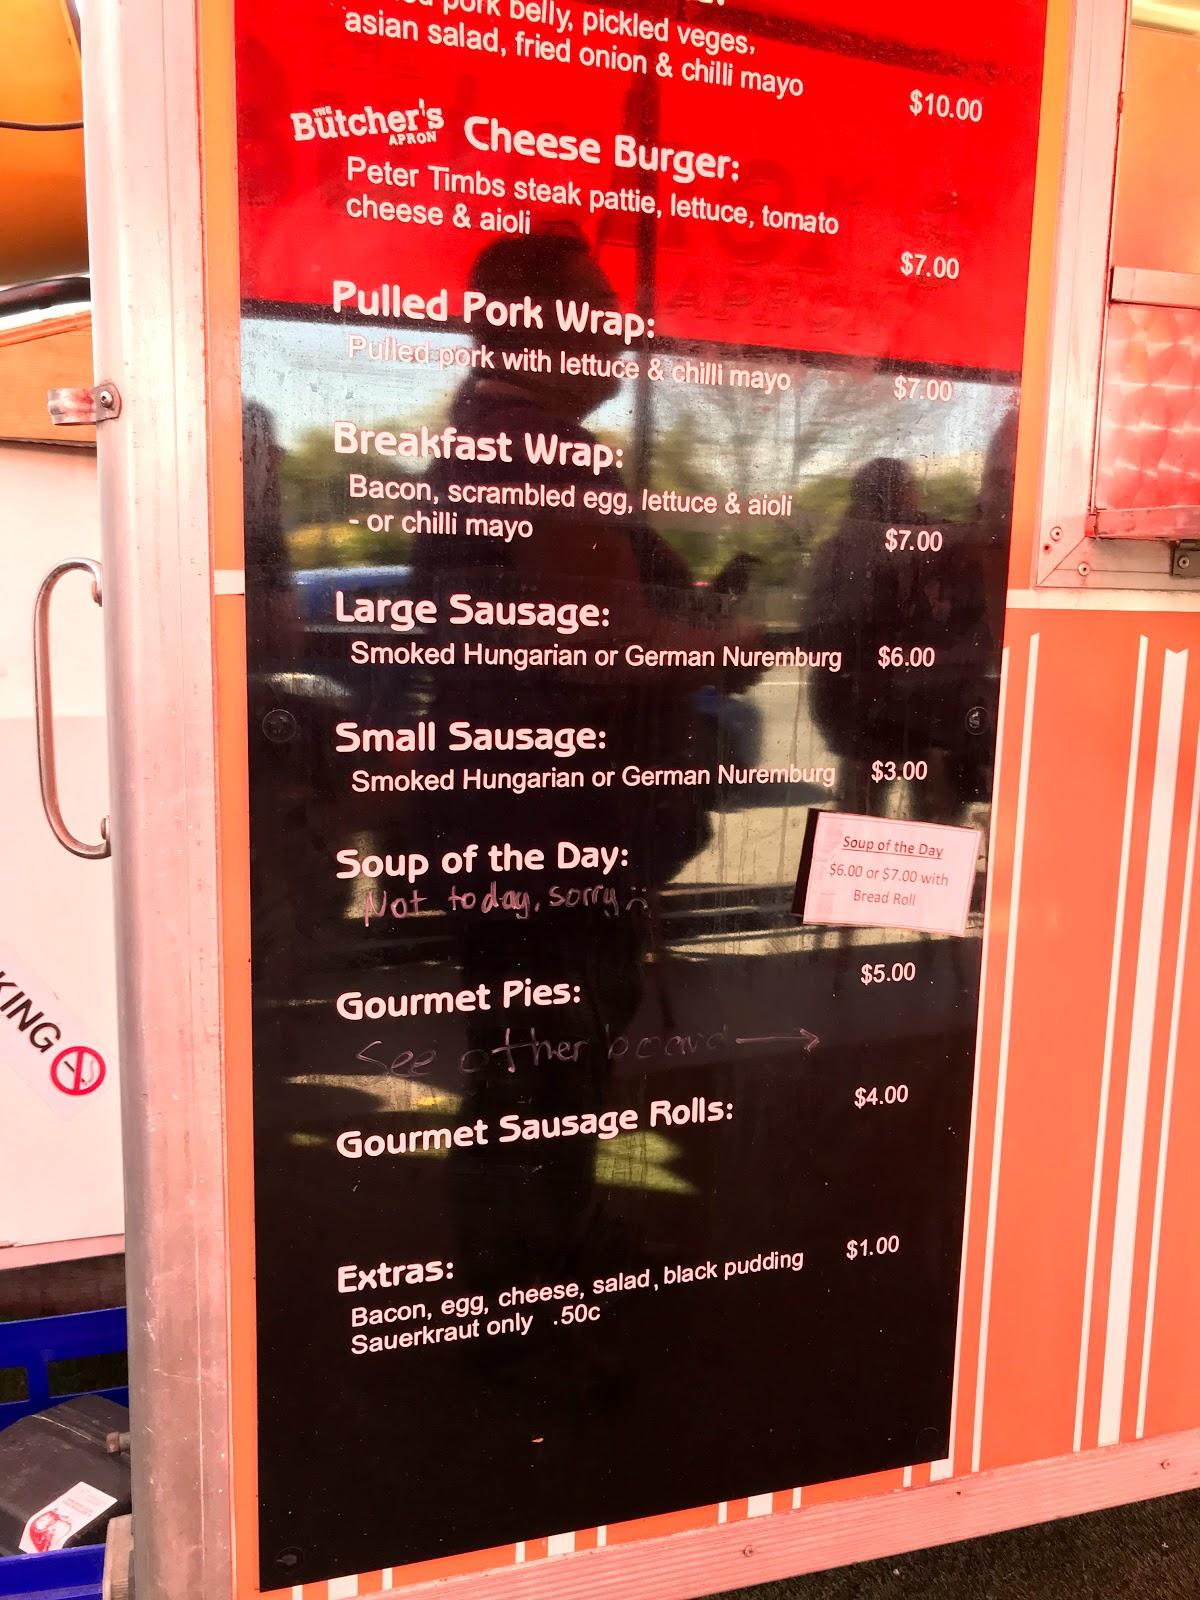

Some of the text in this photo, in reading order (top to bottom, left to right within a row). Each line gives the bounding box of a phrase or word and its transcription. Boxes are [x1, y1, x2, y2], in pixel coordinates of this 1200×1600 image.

[443, 0, 756, 54] pork belly, pickled veges,
[345, 9, 804, 100] asian salad, fried onion & chilli mayo
[312, 106, 331, 116] THE
[909, 89, 983, 122] $10.00
[389, 131, 437, 146] APRON
[464, 116, 739, 183] Cheese Burger:
[348, 156, 839, 235] Peter Timbs steak pattie, lettuce, tomato
[346, 194, 531, 235] cheese & aioli
[900, 251, 959, 280] $7.00
[332, 280, 447, 322] Pulled
[464, 291, 543, 329] Pork
[556, 300, 655, 345] Wrap:
[349, 334, 792, 395] Pulled pork with lettuce & chilli mayo
[893, 375, 952, 402] $7.00
[334, 421, 624, 475] Breakfast Wrap:
[349, 473, 793, 517] Bacon, scrambled egg, lettuce & aioli
[367, 513, 393, 533] or
[401, 511, 457, 535] chilli
[466, 516, 534, 543] mayo
[884, 528, 943, 553] $7.00
[335, 590, 610, 635] Large Sausage:
[350, 640, 842, 672] Smoked Hungarian or German Nuremburg
[877, 645, 936, 669] $6.00
[335, 721, 606, 758] Small Sausage:
[351, 763, 836, 795] Smoked Hungarian or German Nuremburg
[871, 759, 929, 783] $3.00
[336, 841, 629, 885] Soup of the Day:
[843, 836, 945, 858] Soup of the Day
[829, 862, 949, 886] $6.00 or $7.00 with
[364, 889, 429, 928] Not
[853, 889, 916, 906] Bread Roll
[860, 962, 916, 986] $5.00
[336, 977, 581, 1021] Gourmet Pies:
[854, 1084, 909, 1109] $4.00
[336, 1097, 734, 1159] Gourmet Sausage Rolls:
[846, 1235, 900, 1261] $1.00
[337, 1260, 454, 1294] Extras:
[351, 1301, 433, 1328] Bacon,
[440, 1293, 489, 1318] egg,
[498, 1281, 585, 1308] cheese,
[663, 1260, 718, 1285] black
[724, 1251, 804, 1281] pudding
[351, 1305, 601, 1355] Sauerkraut only .50c
